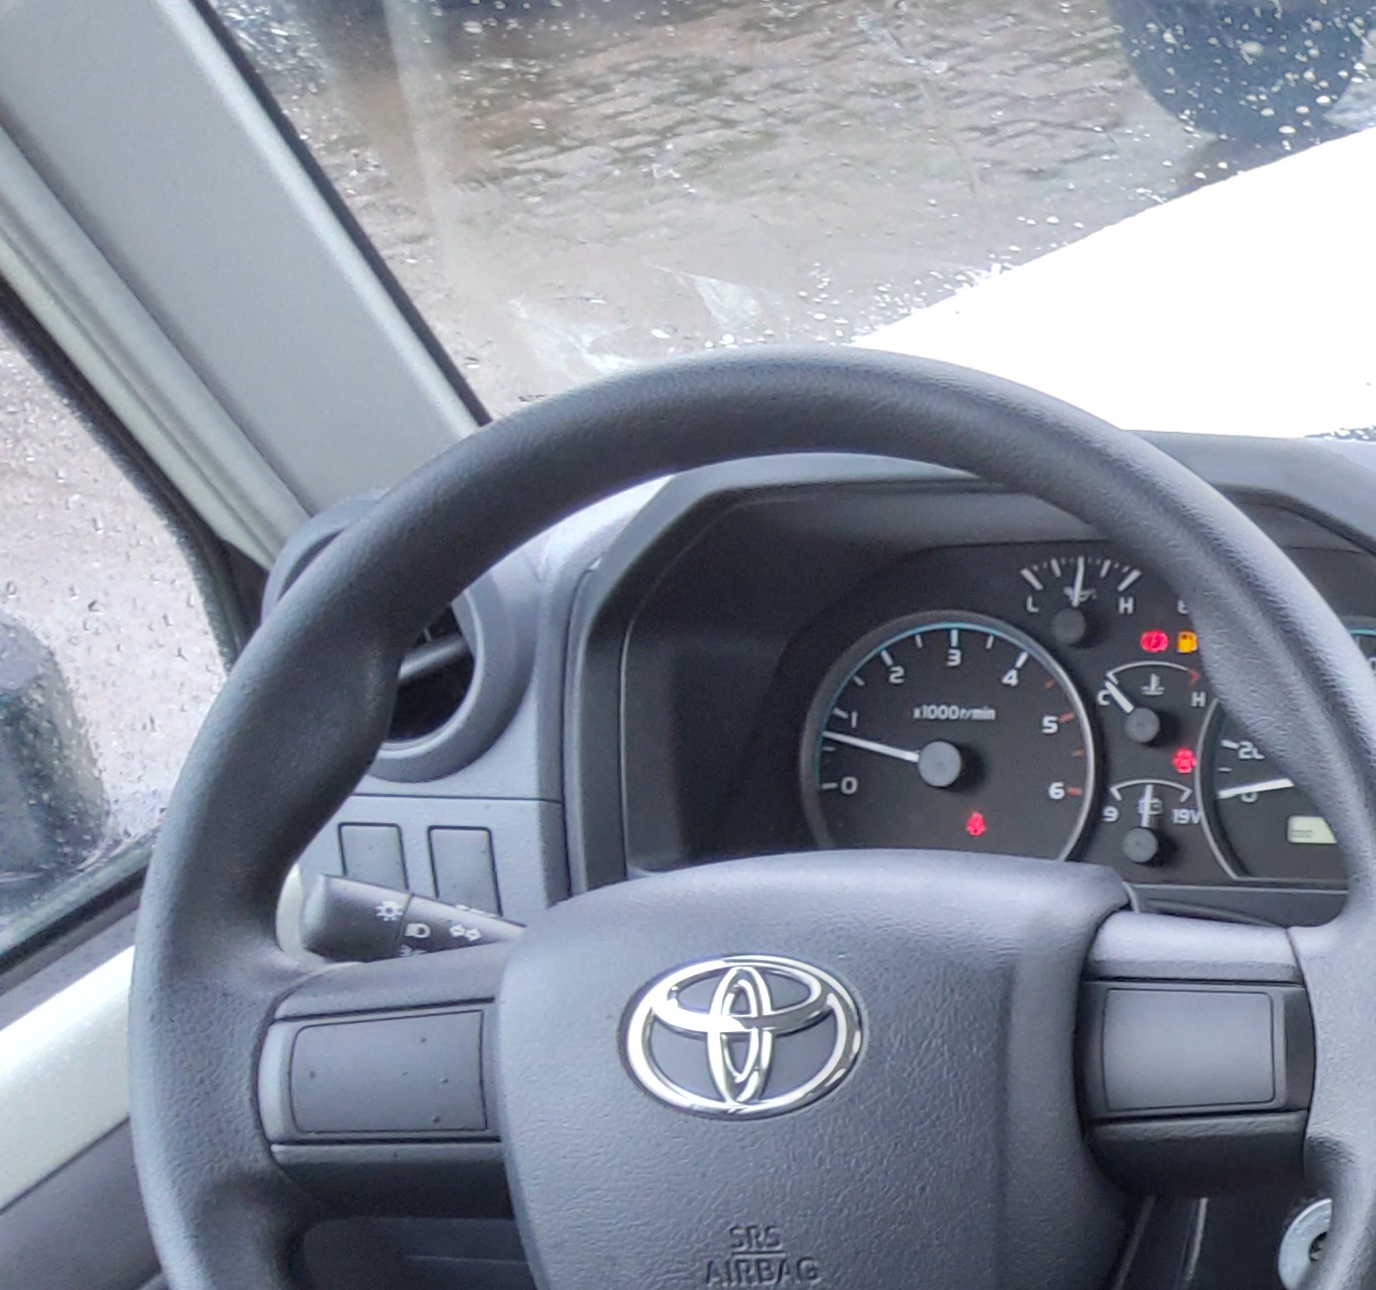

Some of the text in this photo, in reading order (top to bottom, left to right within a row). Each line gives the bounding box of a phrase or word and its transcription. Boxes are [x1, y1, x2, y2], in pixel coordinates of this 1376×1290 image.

[1026, 595, 1040, 613] L
[1118, 596, 1134, 614] H
[946, 649, 962, 666] 3
[889, 666, 905, 684] 2
[1000, 669, 1019, 687] 4
[1190, 691, 1207, 708] H
[850, 711, 859, 729] 1
[1041, 715, 1060, 734] 5
[841, 776, 858, 795] 0
[1048, 781, 1066, 800] 6
[1102, 805, 1119, 823] 9
[729, 1224, 784, 1251] SRS
[705, 1255, 822, 1286] AIRBAG
